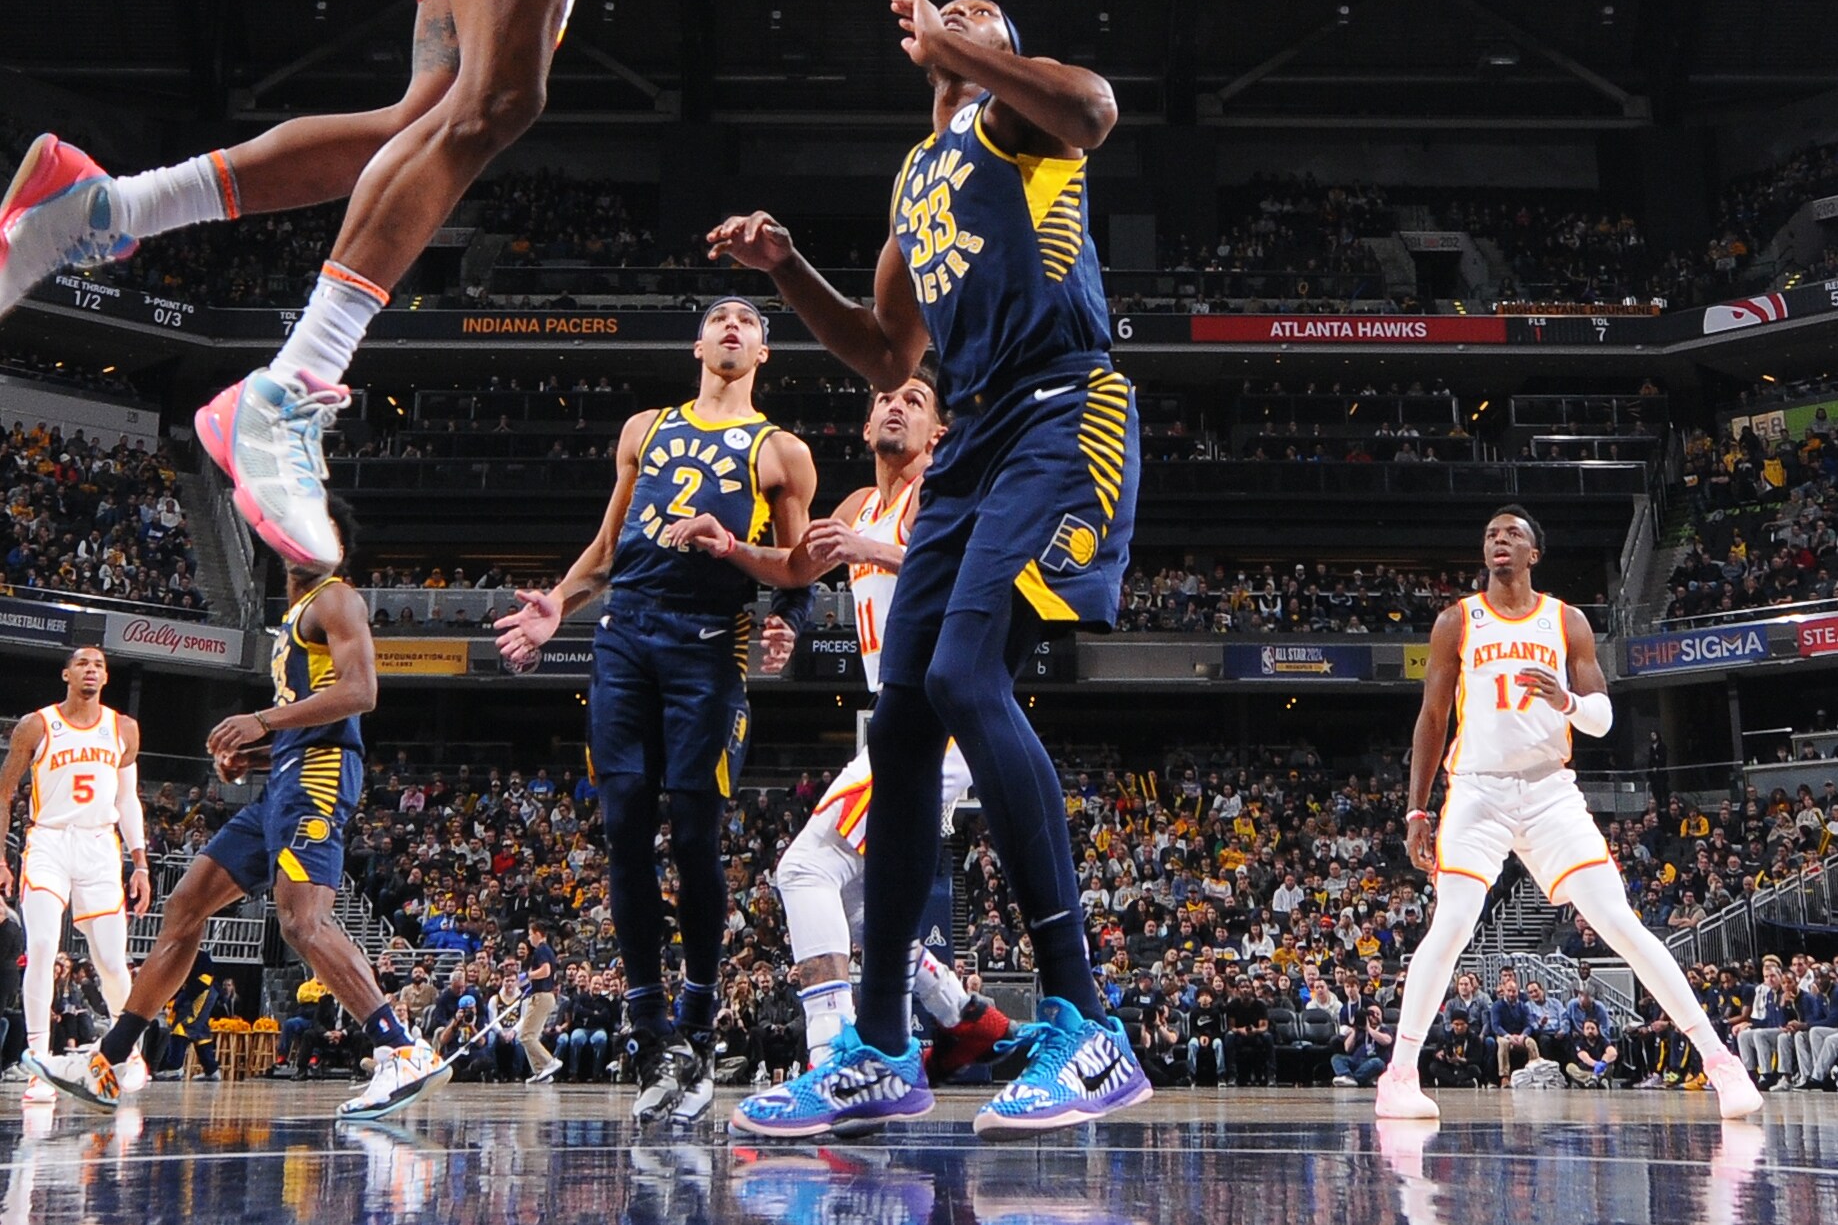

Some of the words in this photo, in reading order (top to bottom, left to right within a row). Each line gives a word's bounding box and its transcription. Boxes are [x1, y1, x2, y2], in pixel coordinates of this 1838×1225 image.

[909, 181, 957, 268] 33
[55, 275, 80, 288] FREE
[81, 280, 121, 298] THROWS
[73, 290, 101, 311] 1/2
[144, 296, 180, 311] 3-POINT
[182, 304, 195, 314] FG
[1503, 305, 1533, 315] HIGH
[1535, 305, 1586, 315] OCTANE
[1589, 305, 1653, 315] DRUMLINE
[153, 308, 182, 327] 0/3
[280, 311, 298, 320] TOL
[462, 317, 539, 333] INDIANA
[545, 317, 618, 333] PACERS
[1528, 318, 1547, 326] FLS
[1591, 318, 1610, 326] TOL
[1117, 317, 1133, 339] 6
[1270, 322, 1353, 338] ATLANTA
[1357, 322, 1428, 338] HAWKS
[1595, 327, 1606, 342] 7
[643, 438, 742, 494] INDIANA
[666, 466, 703, 518] 2
[46, 618, 67, 633] HERE
[857, 597, 881, 657] 11
[122, 619, 182, 654] Bally
[183, 636, 226, 654] SPORTS
[1803, 627, 1838, 646] STE
[812, 640, 857, 653] PACERS
[1473, 641, 1558, 671] ATLANTA
[543, 653, 594, 663] INDIANA
[837, 659, 847, 674] 3
[1494, 673, 1540, 713] 17
[49, 747, 117, 772] ATLANTA
[72, 774, 96, 805] 5
